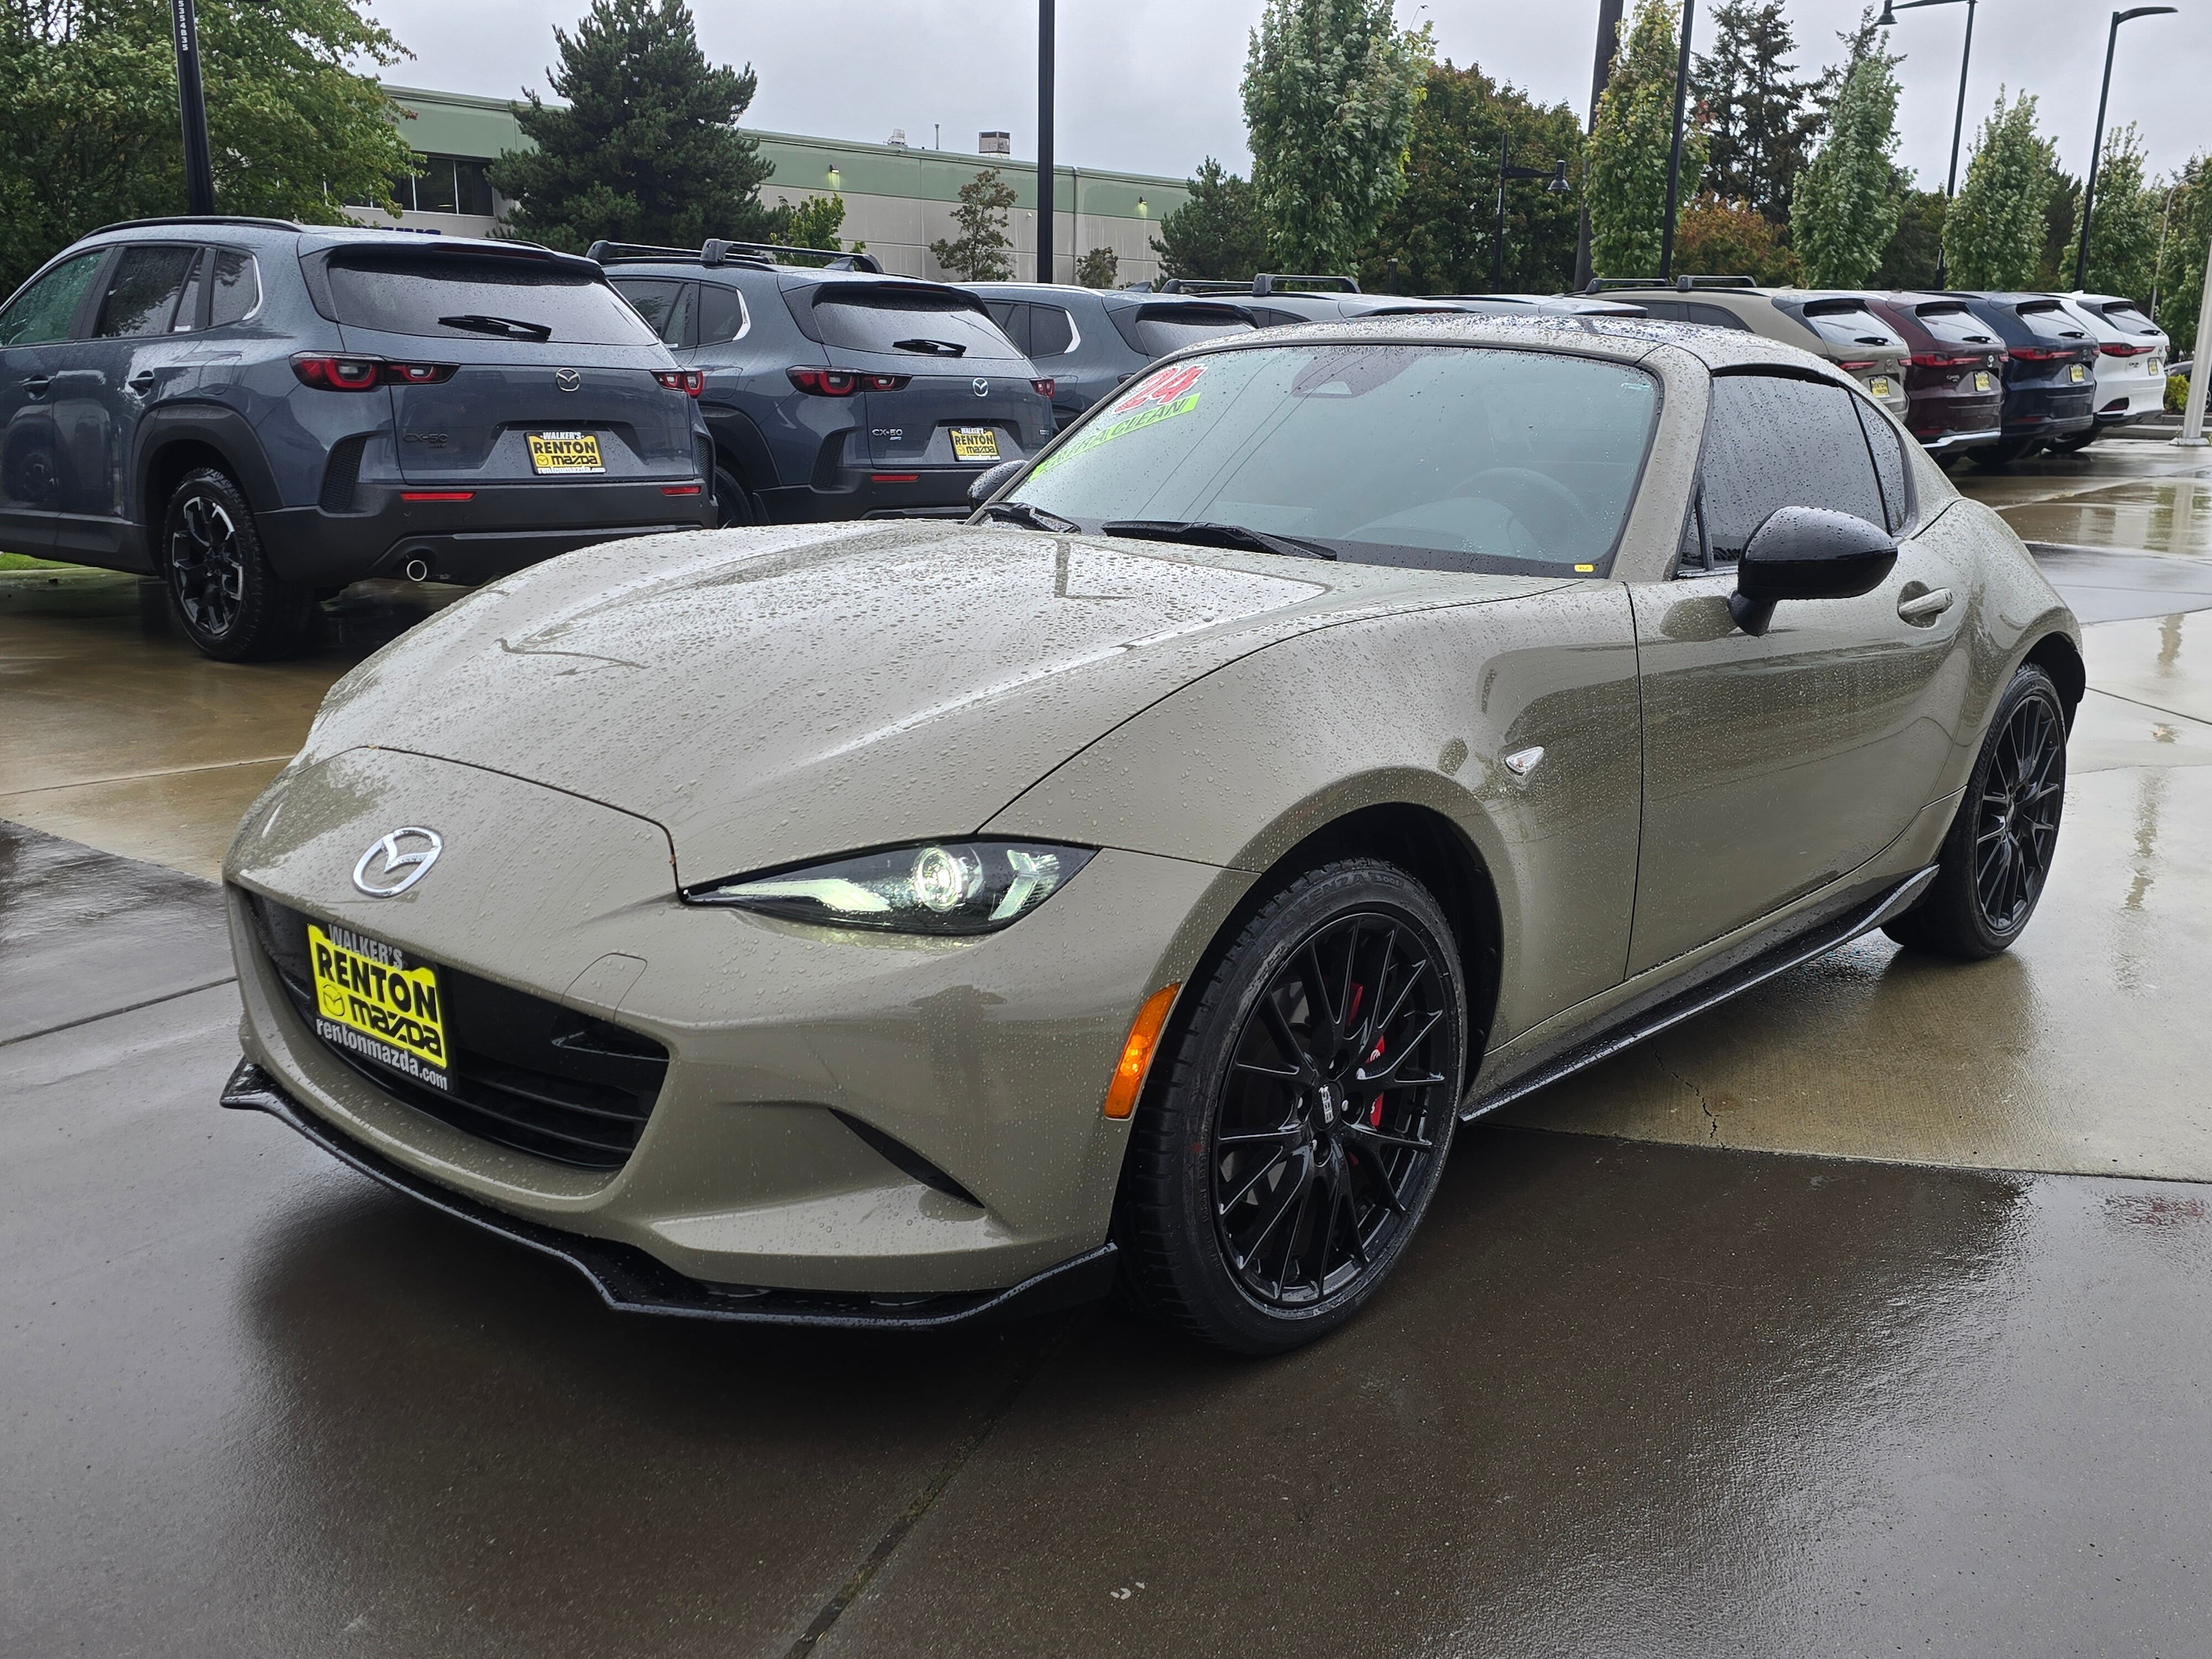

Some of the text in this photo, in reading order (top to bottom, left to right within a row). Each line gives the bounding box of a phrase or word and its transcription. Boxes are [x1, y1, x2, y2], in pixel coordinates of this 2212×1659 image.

[1113, 364, 1207, 414] 24
[542, 431, 582, 440] WALKER'S
[1113, 398, 1187, 436] CLEAN
[533, 441, 596, 454] RENTON
[954, 435, 994, 446] RENTON
[328, 923, 403, 970] WALKER'S
[315, 941, 439, 1024] RENTON
[316, 1018, 448, 1091] rentonmazda.com
